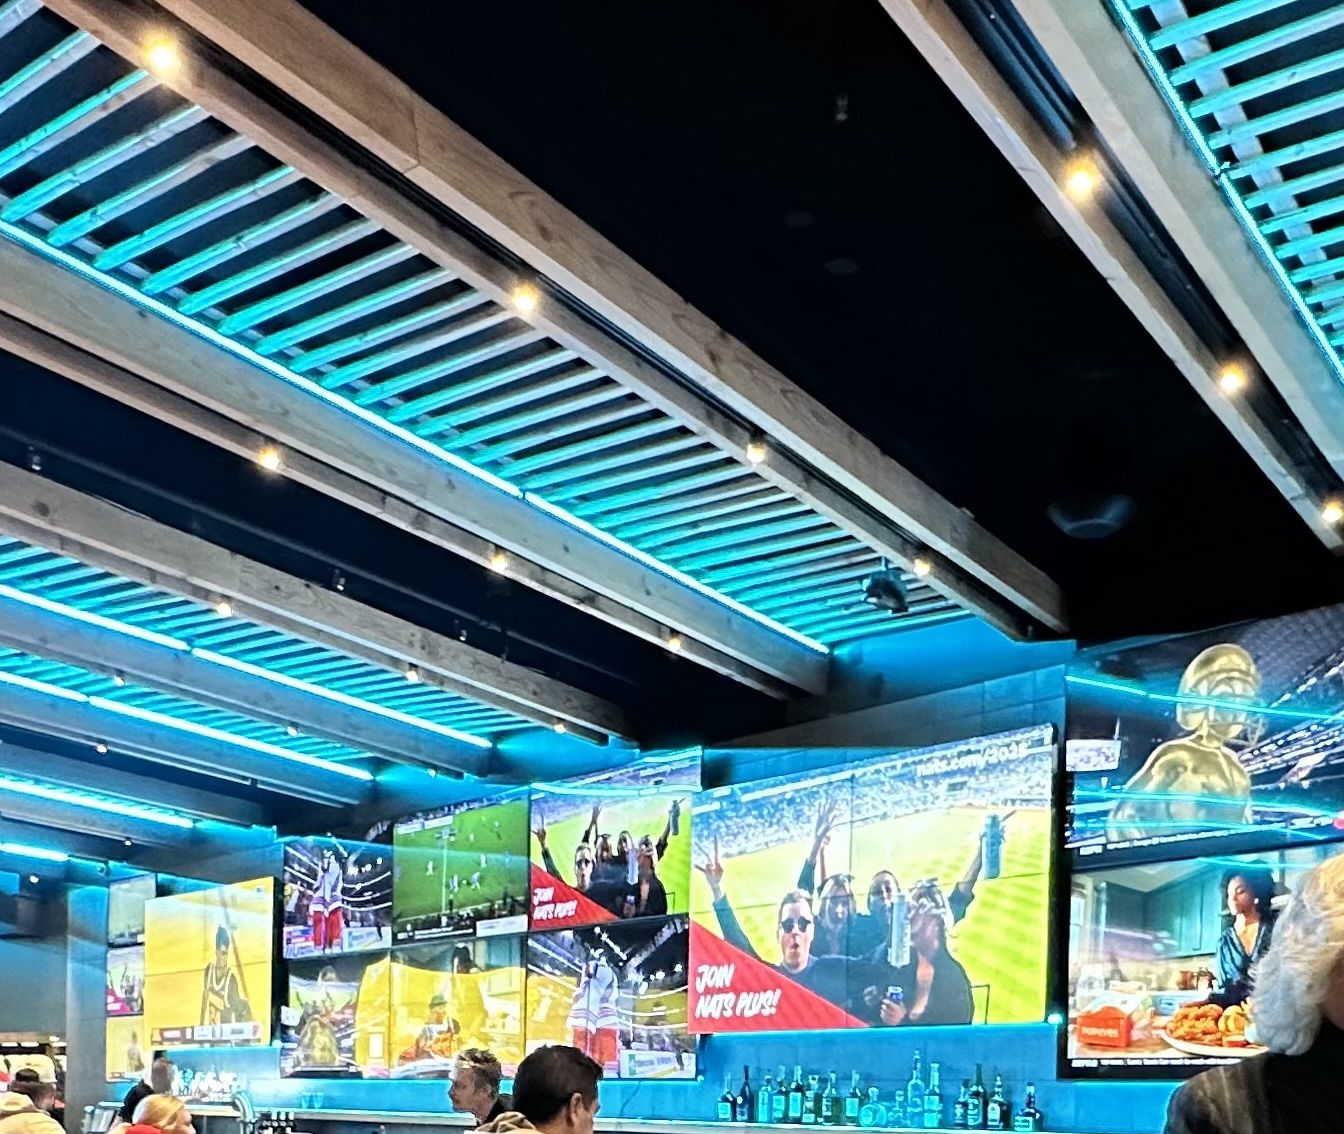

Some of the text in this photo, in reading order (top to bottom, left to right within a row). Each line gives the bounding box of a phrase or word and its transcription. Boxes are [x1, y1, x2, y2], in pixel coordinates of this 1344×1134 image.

[696, 963, 735, 994] JOIN
[695, 988, 782, 1019] NATS PLUS!
